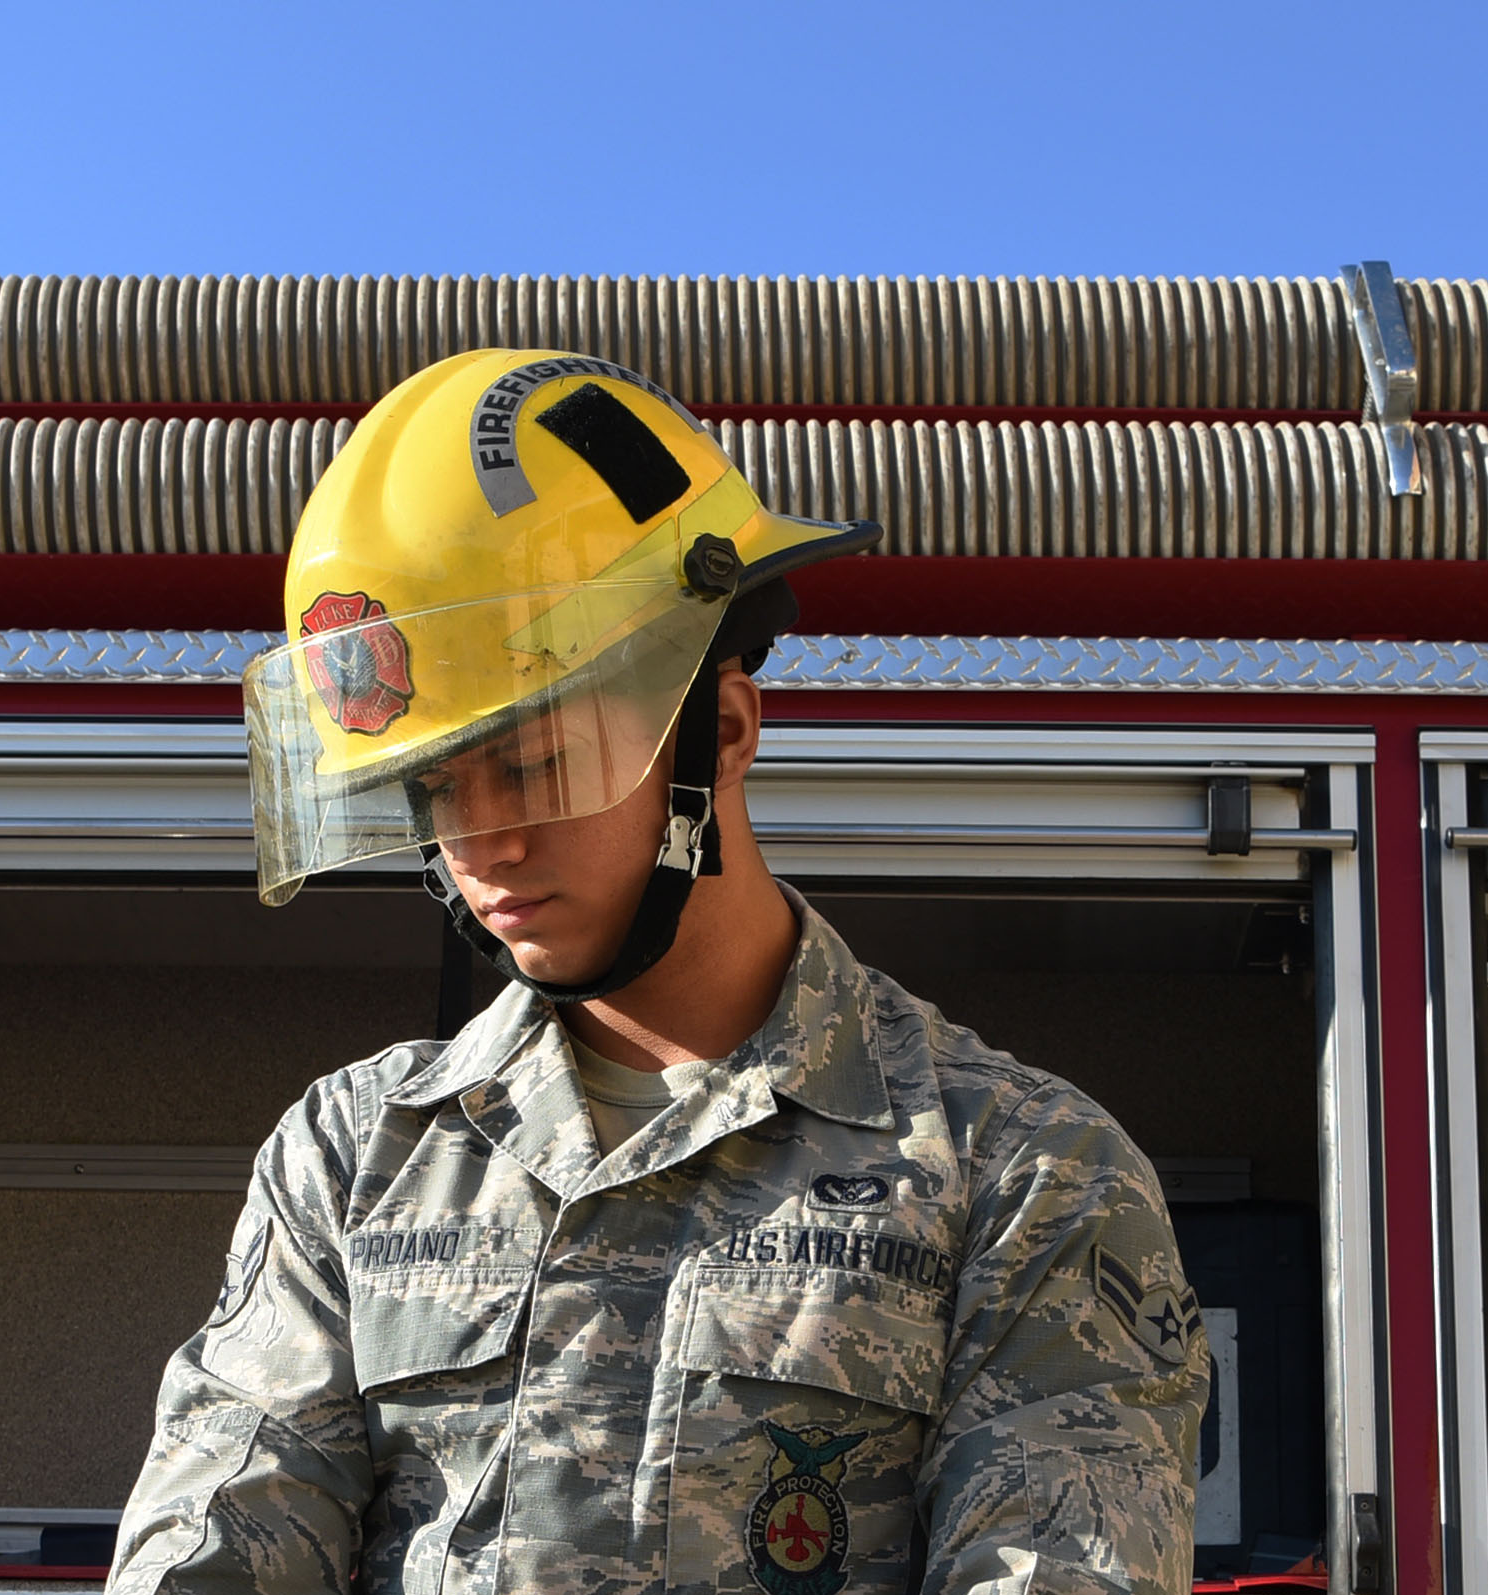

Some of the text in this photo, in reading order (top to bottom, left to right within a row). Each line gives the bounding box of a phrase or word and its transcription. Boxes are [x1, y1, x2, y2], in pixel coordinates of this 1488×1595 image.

[476, 358, 673, 471] FIREFIGHTER
[314, 603, 356, 631] LUKE
[792, 1230, 847, 1266] AIR
[852, 1235, 952, 1289] FORCE
[752, 1475, 845, 1556] FIRE PROTECTION
